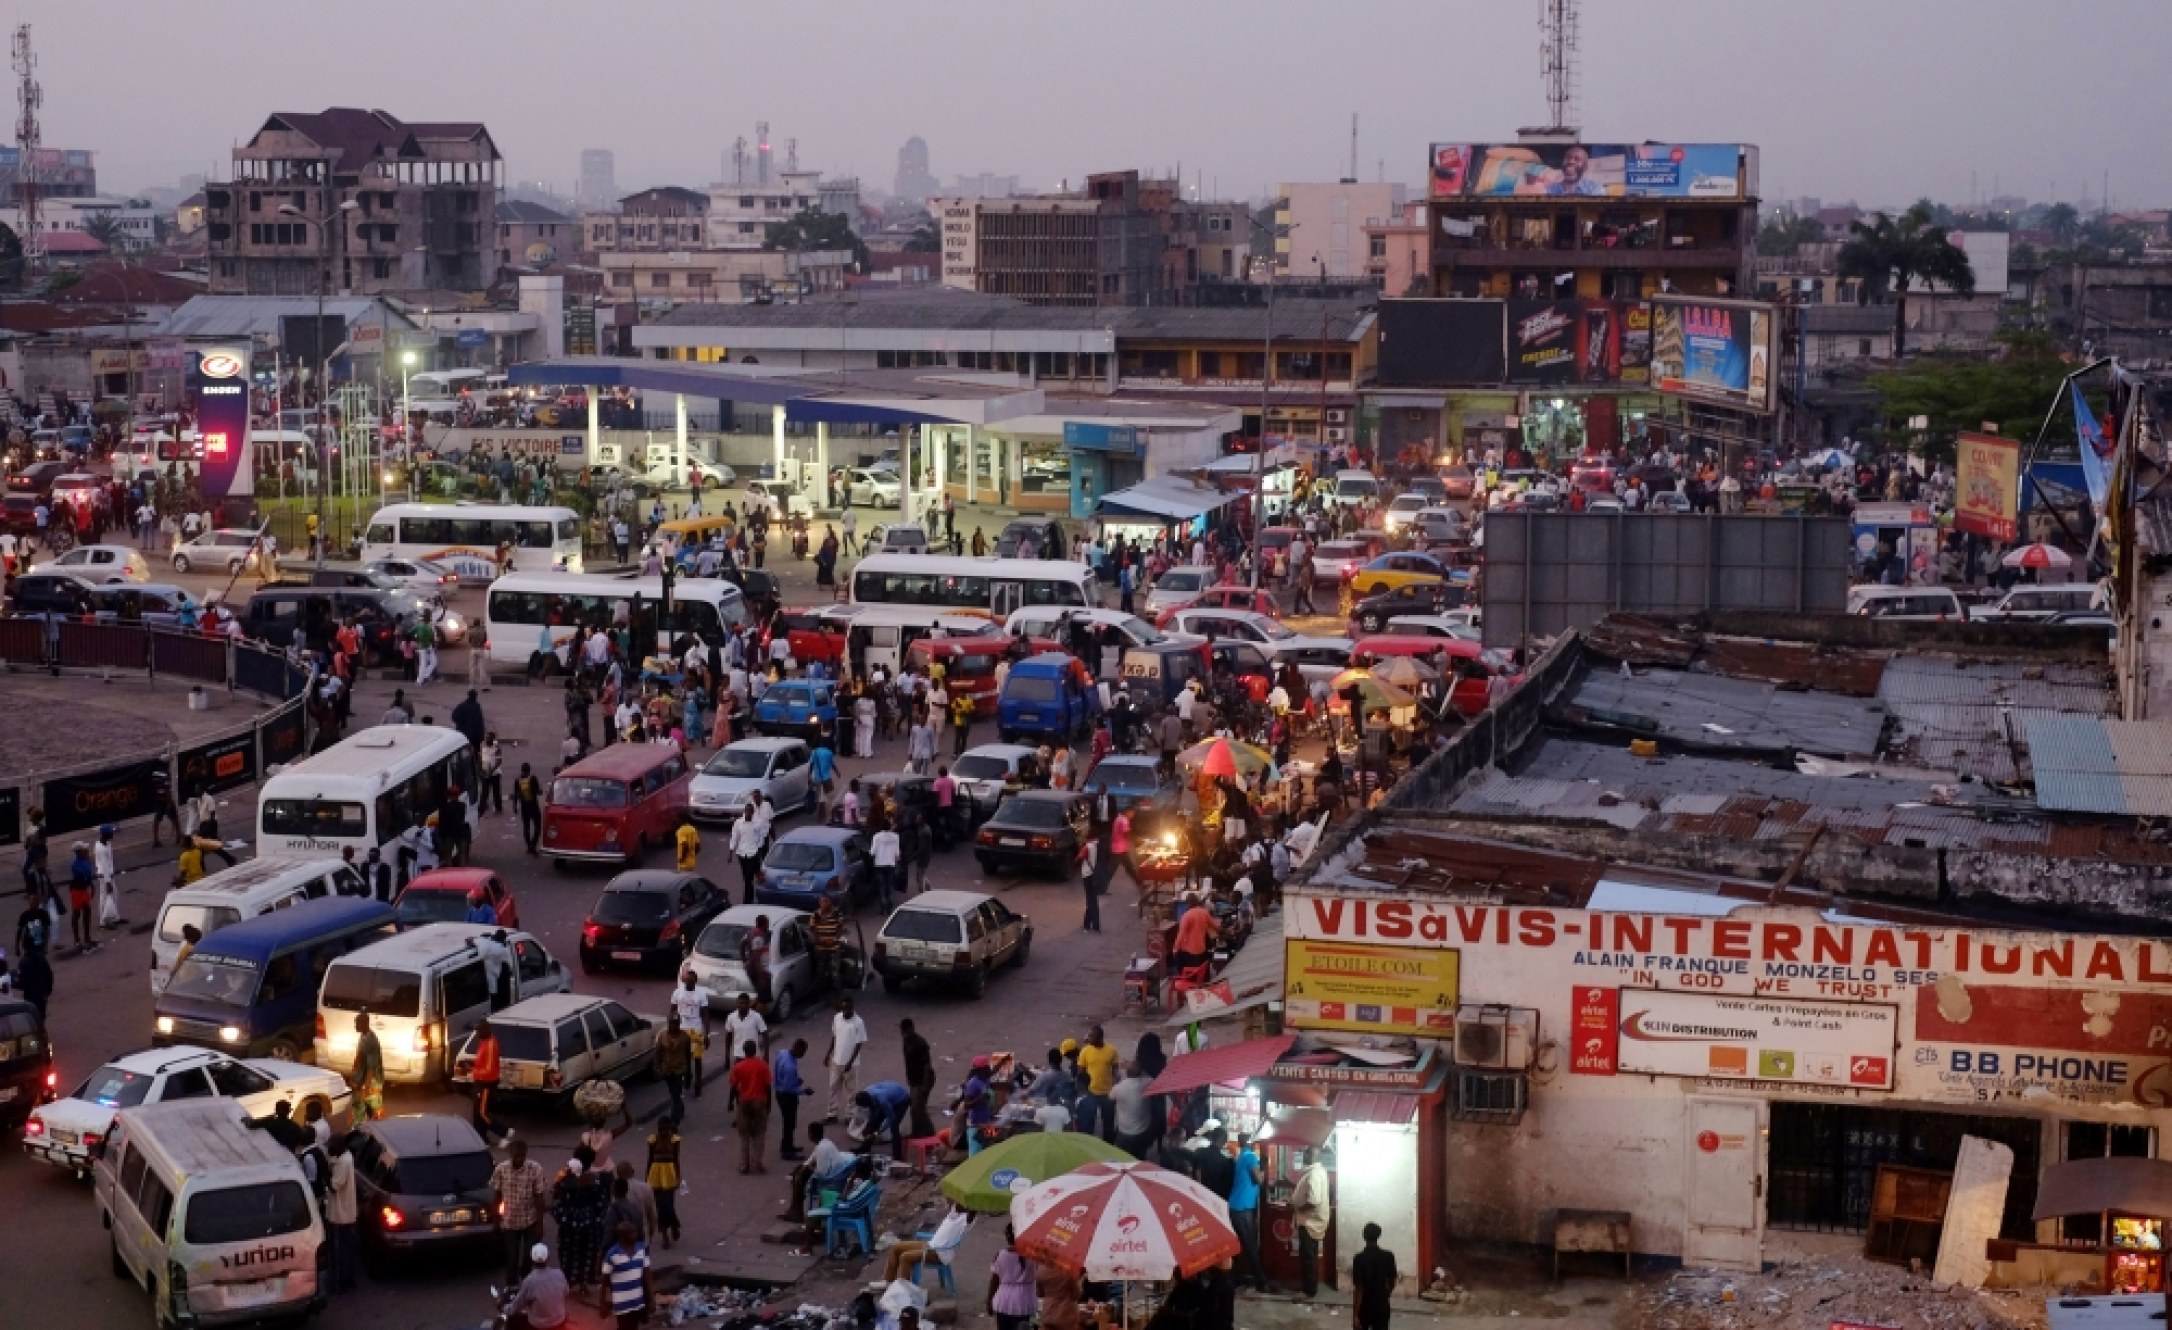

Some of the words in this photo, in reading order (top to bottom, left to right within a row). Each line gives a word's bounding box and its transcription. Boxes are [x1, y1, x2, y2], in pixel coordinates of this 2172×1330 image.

[75, 785, 138, 812] Orange
[1573, 951, 1634, 968] ALAIN
[1643, 956, 1749, 974] FRANQUE
[1765, 962, 1876, 981] MONZELO
[1679, 973, 1724, 988] GOD
[1753, 978, 1790, 992] WE
[1580, 1004, 1608, 1016] airtel
[1671, 1023, 1758, 1040] DISTRIBUTION
[1576, 1055, 1610, 1070] airtel
[2015, 1053, 2129, 1084] PHONE
[1109, 1239, 1148, 1253] airtel
